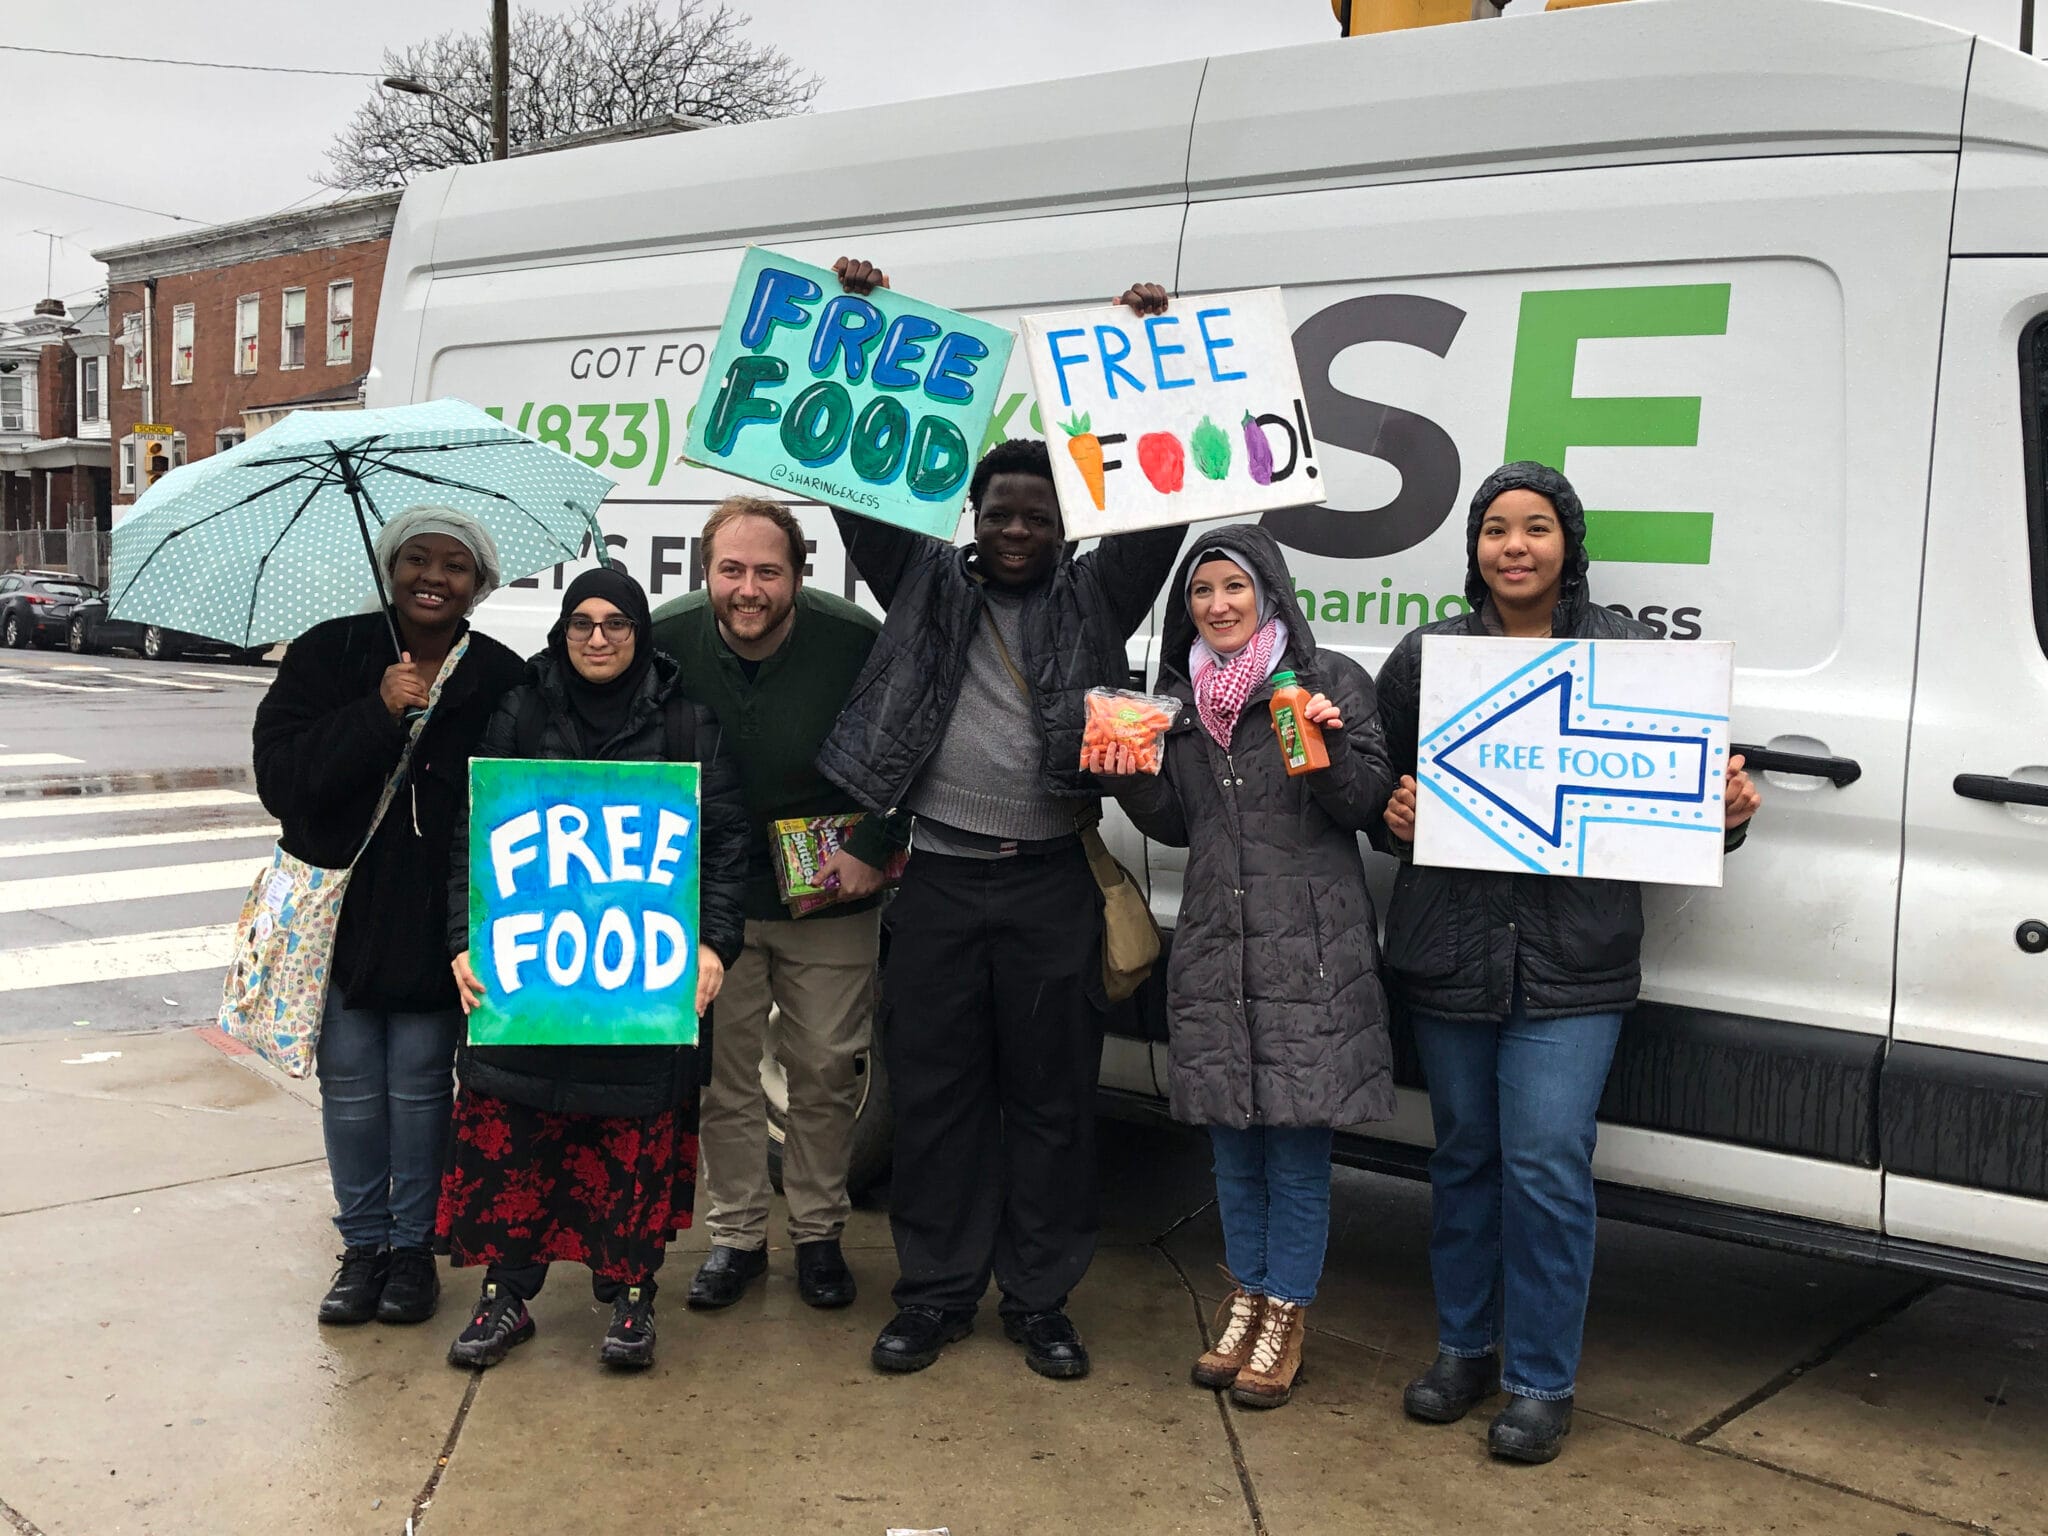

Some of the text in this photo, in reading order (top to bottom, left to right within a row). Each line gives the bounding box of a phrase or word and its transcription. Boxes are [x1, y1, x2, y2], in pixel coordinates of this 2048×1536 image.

[570, 343, 705, 380] GOT FO
[741, 268, 989, 403] FREE
[1047, 308, 1247, 406] FREE
[704, 356, 969, 499] FOOD
[770, 463, 881, 509] @SHARINGEXCESS
[1291, 577, 1471, 625] harin
[1478, 743, 1545, 770] FREE
[1558, 747, 1655, 779] FOOD
[490, 803, 692, 899] FREE
[492, 906, 688, 994] FOOD
